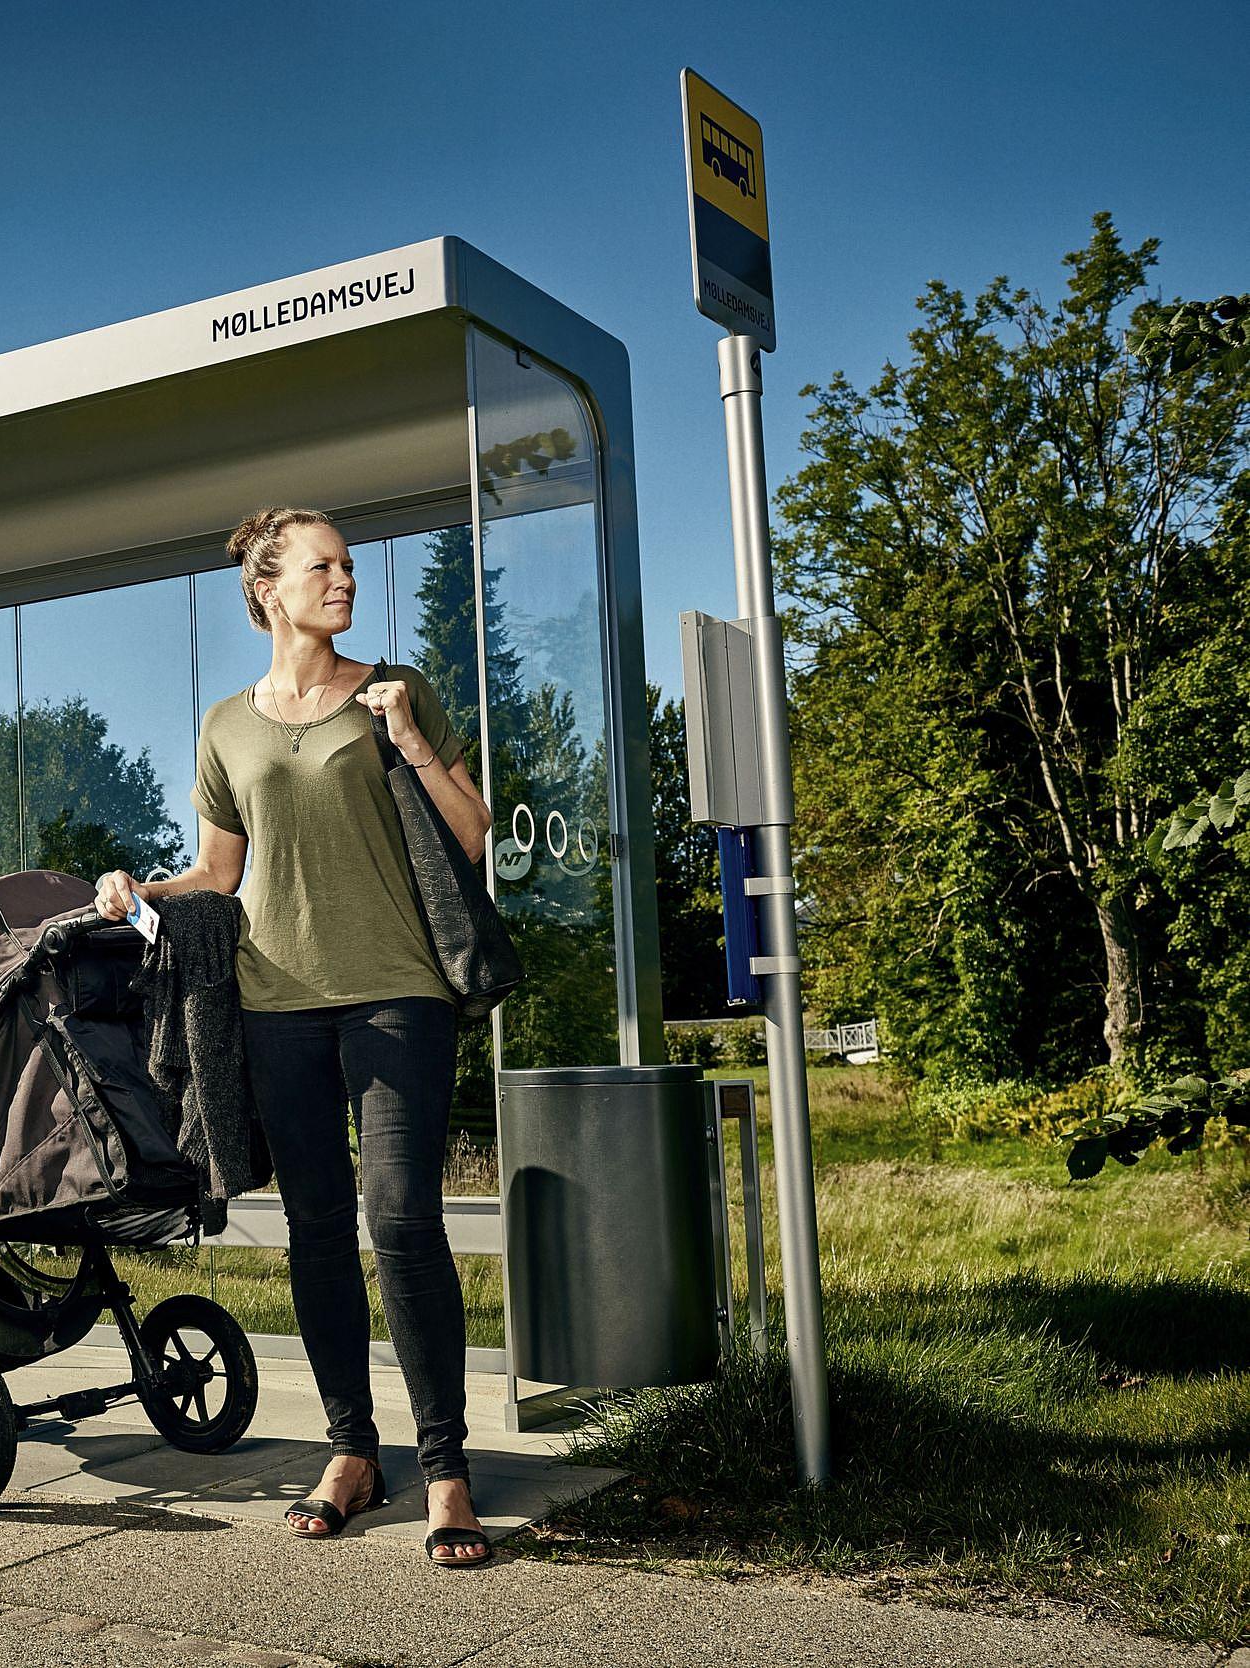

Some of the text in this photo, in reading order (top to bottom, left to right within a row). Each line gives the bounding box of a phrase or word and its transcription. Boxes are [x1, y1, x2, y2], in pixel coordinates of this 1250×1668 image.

[212, 268, 414, 342] MØLLEDAMSVEJ
[703, 278, 770, 332] MØLLEDAMSVEJ
[497, 852, 528, 867] NT
